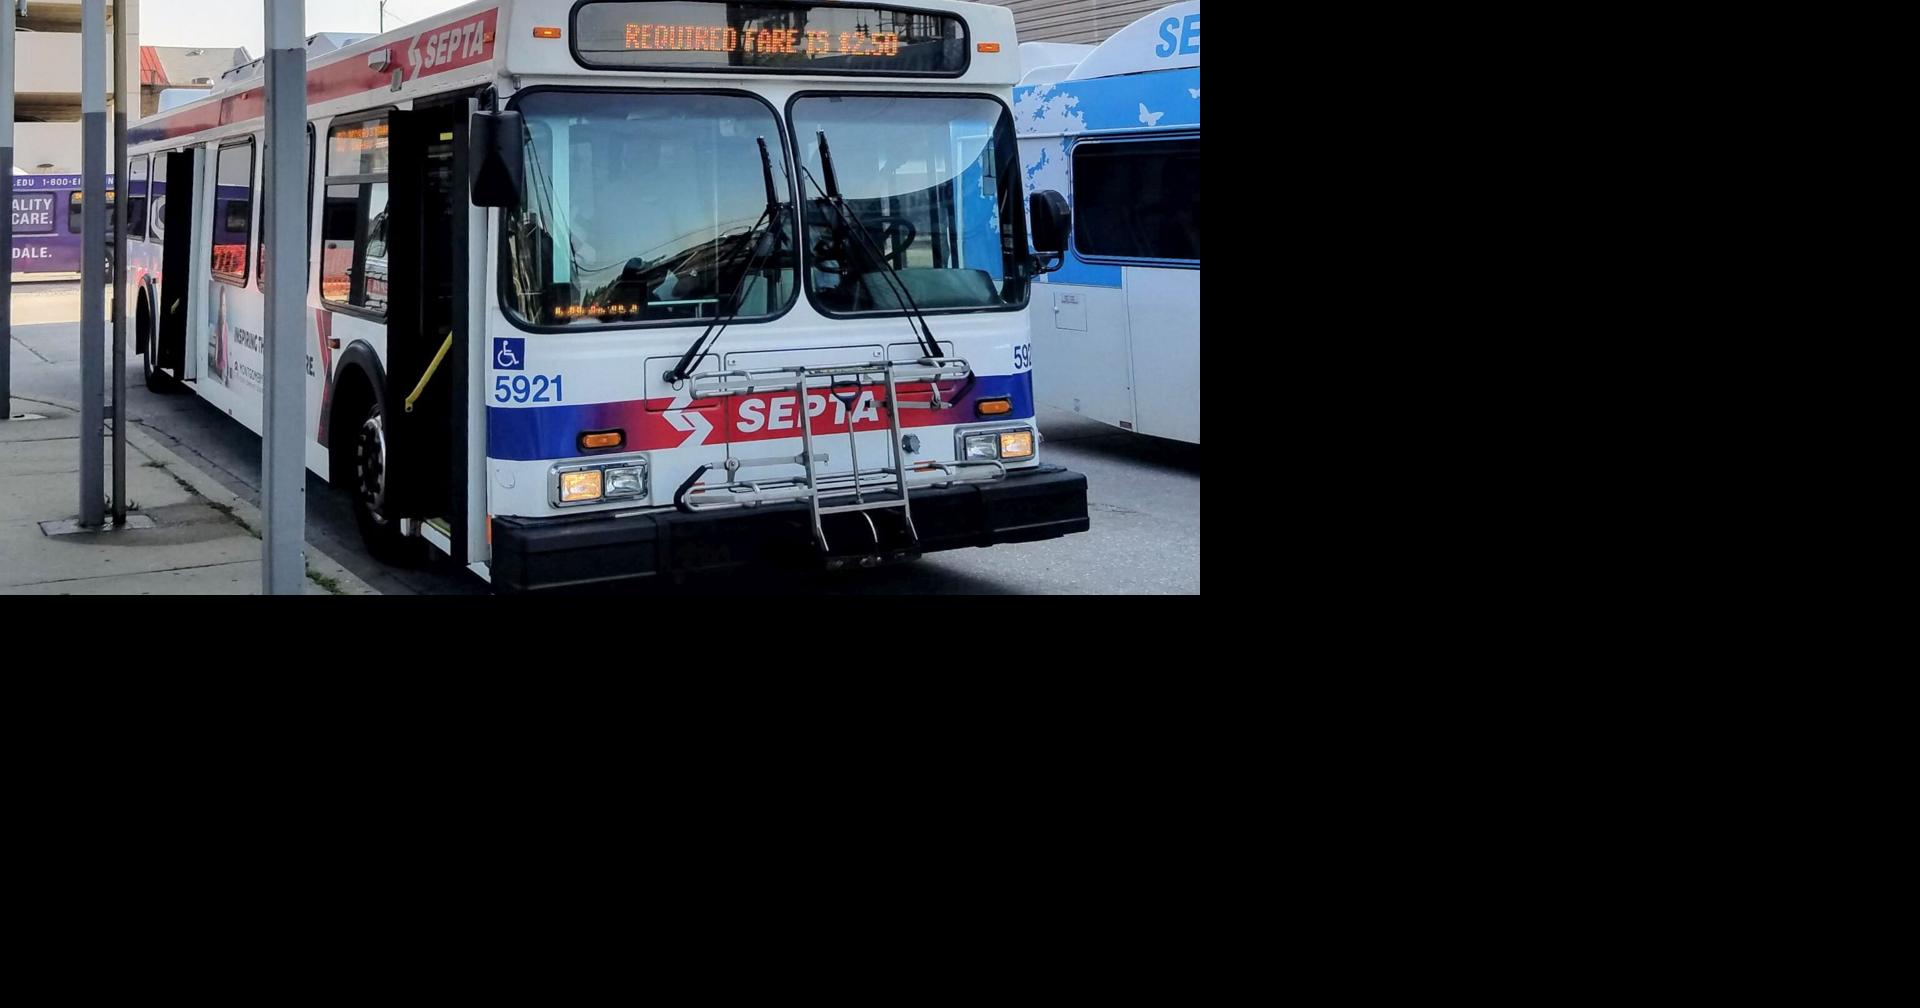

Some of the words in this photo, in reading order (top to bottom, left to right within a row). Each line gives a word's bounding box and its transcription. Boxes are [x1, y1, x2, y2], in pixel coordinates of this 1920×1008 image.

[424, 20, 484, 69] SEPTA
[625, 23, 737, 51] REQUIRED
[744, 28, 799, 53] FARE
[806, 30, 829, 54] IS
[838, 31, 897, 56] $2.50
[12, 212, 53, 225] CARE.
[494, 374, 563, 403] 5921
[736, 390, 879, 433] SEPTA
